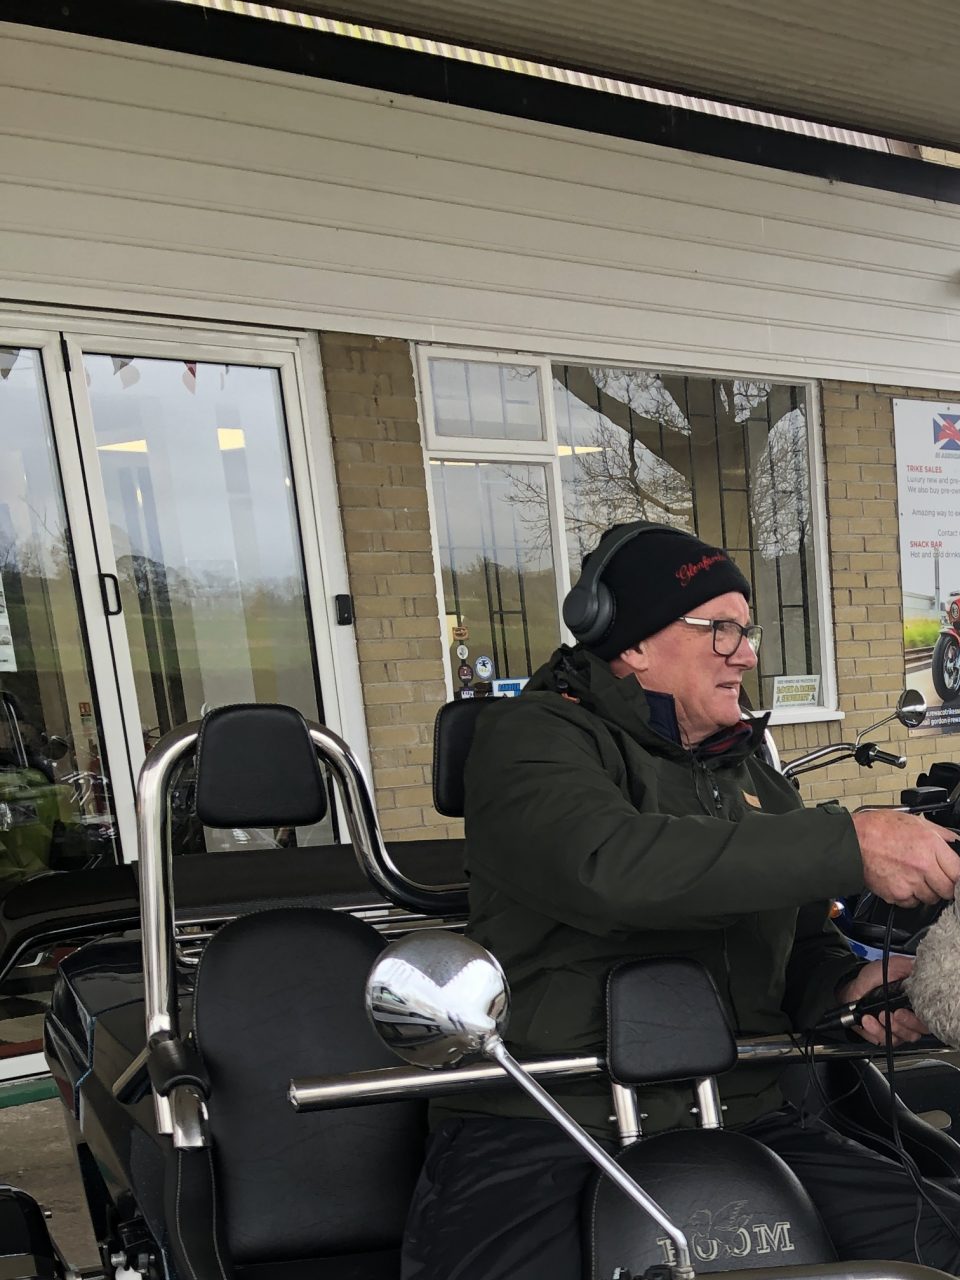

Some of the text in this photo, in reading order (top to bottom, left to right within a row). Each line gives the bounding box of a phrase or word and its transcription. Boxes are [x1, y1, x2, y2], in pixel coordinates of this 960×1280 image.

[906, 465, 942, 474] TRIKE SALES
[907, 476, 925, 485] Luxury
[918, 486, 929, 494] also
[930, 486, 940, 496] buy
[912, 508, 936, 518] Amazing
[936, 510, 947, 518] way
[938, 529, 958, 537] Contact
